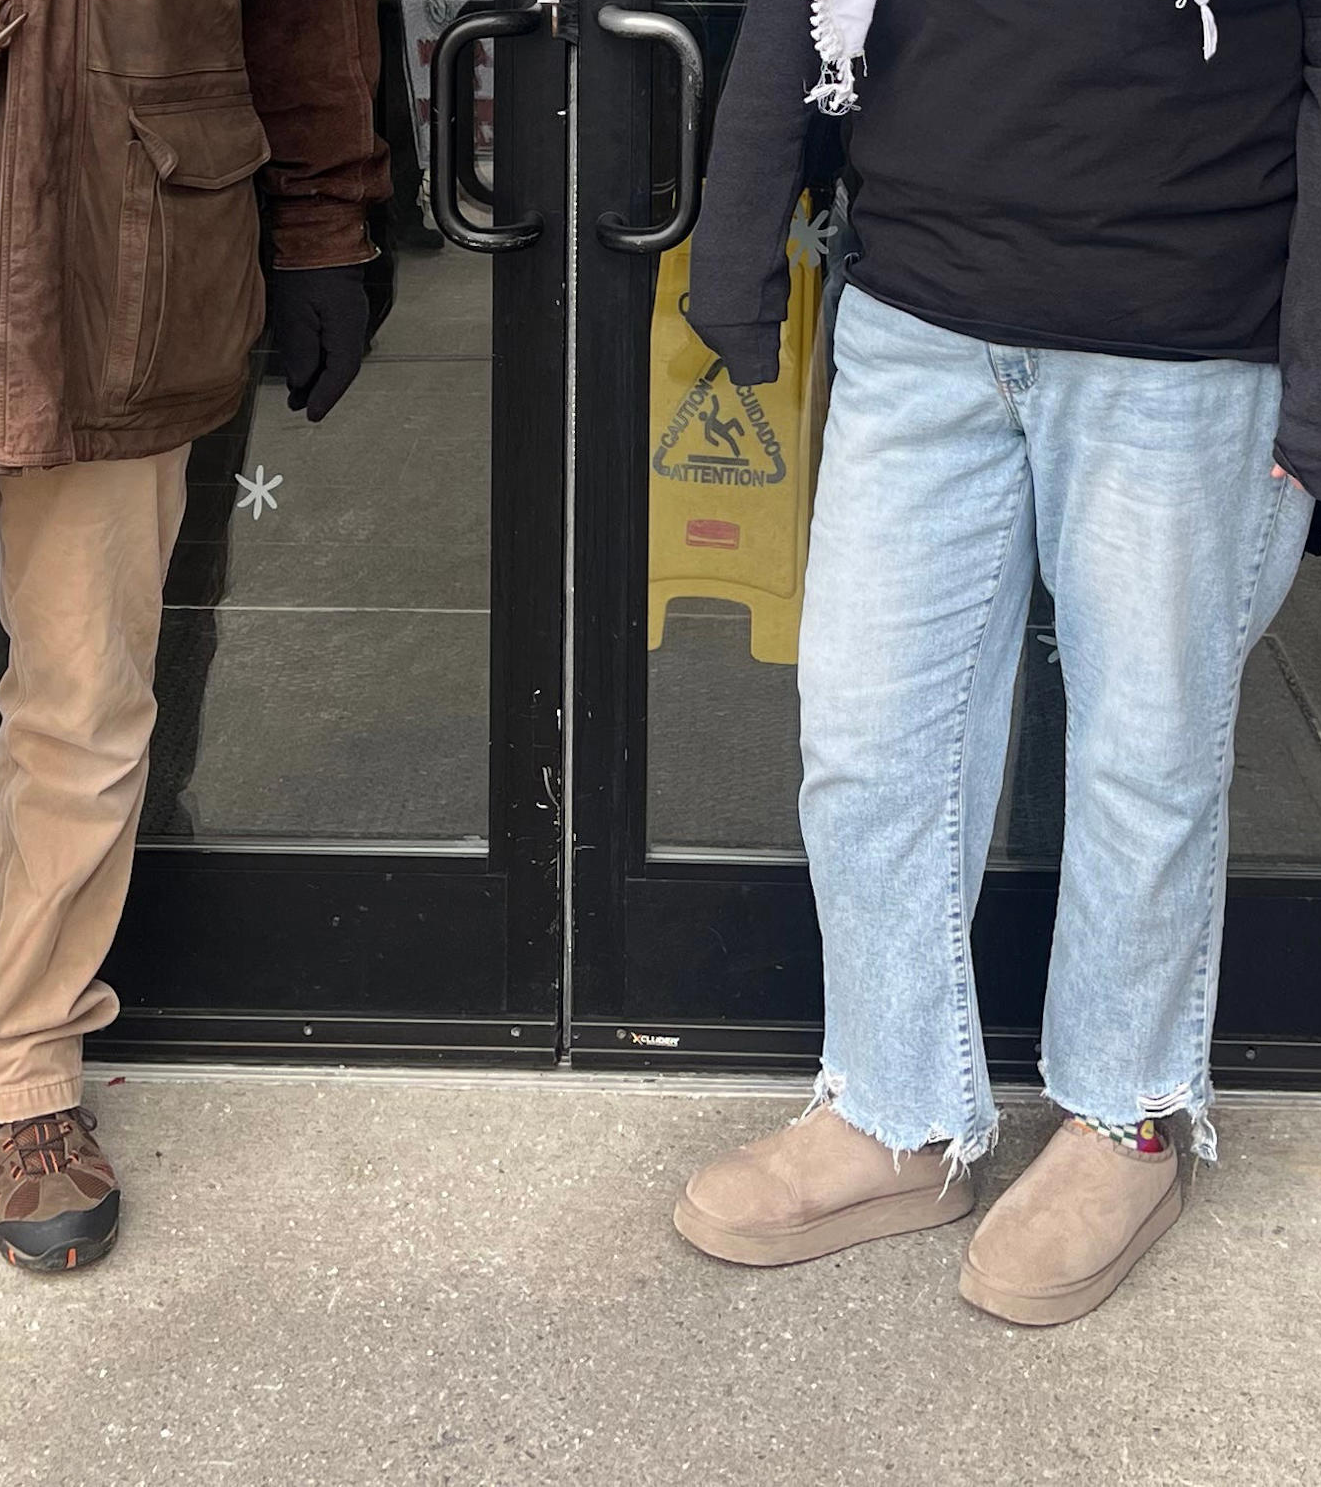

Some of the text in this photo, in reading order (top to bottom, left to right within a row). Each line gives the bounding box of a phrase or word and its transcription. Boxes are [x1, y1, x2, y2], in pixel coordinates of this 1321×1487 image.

[660, 378, 781, 456] CAUTION CUIDADO
[670, 464, 765, 487] ATTENTION
